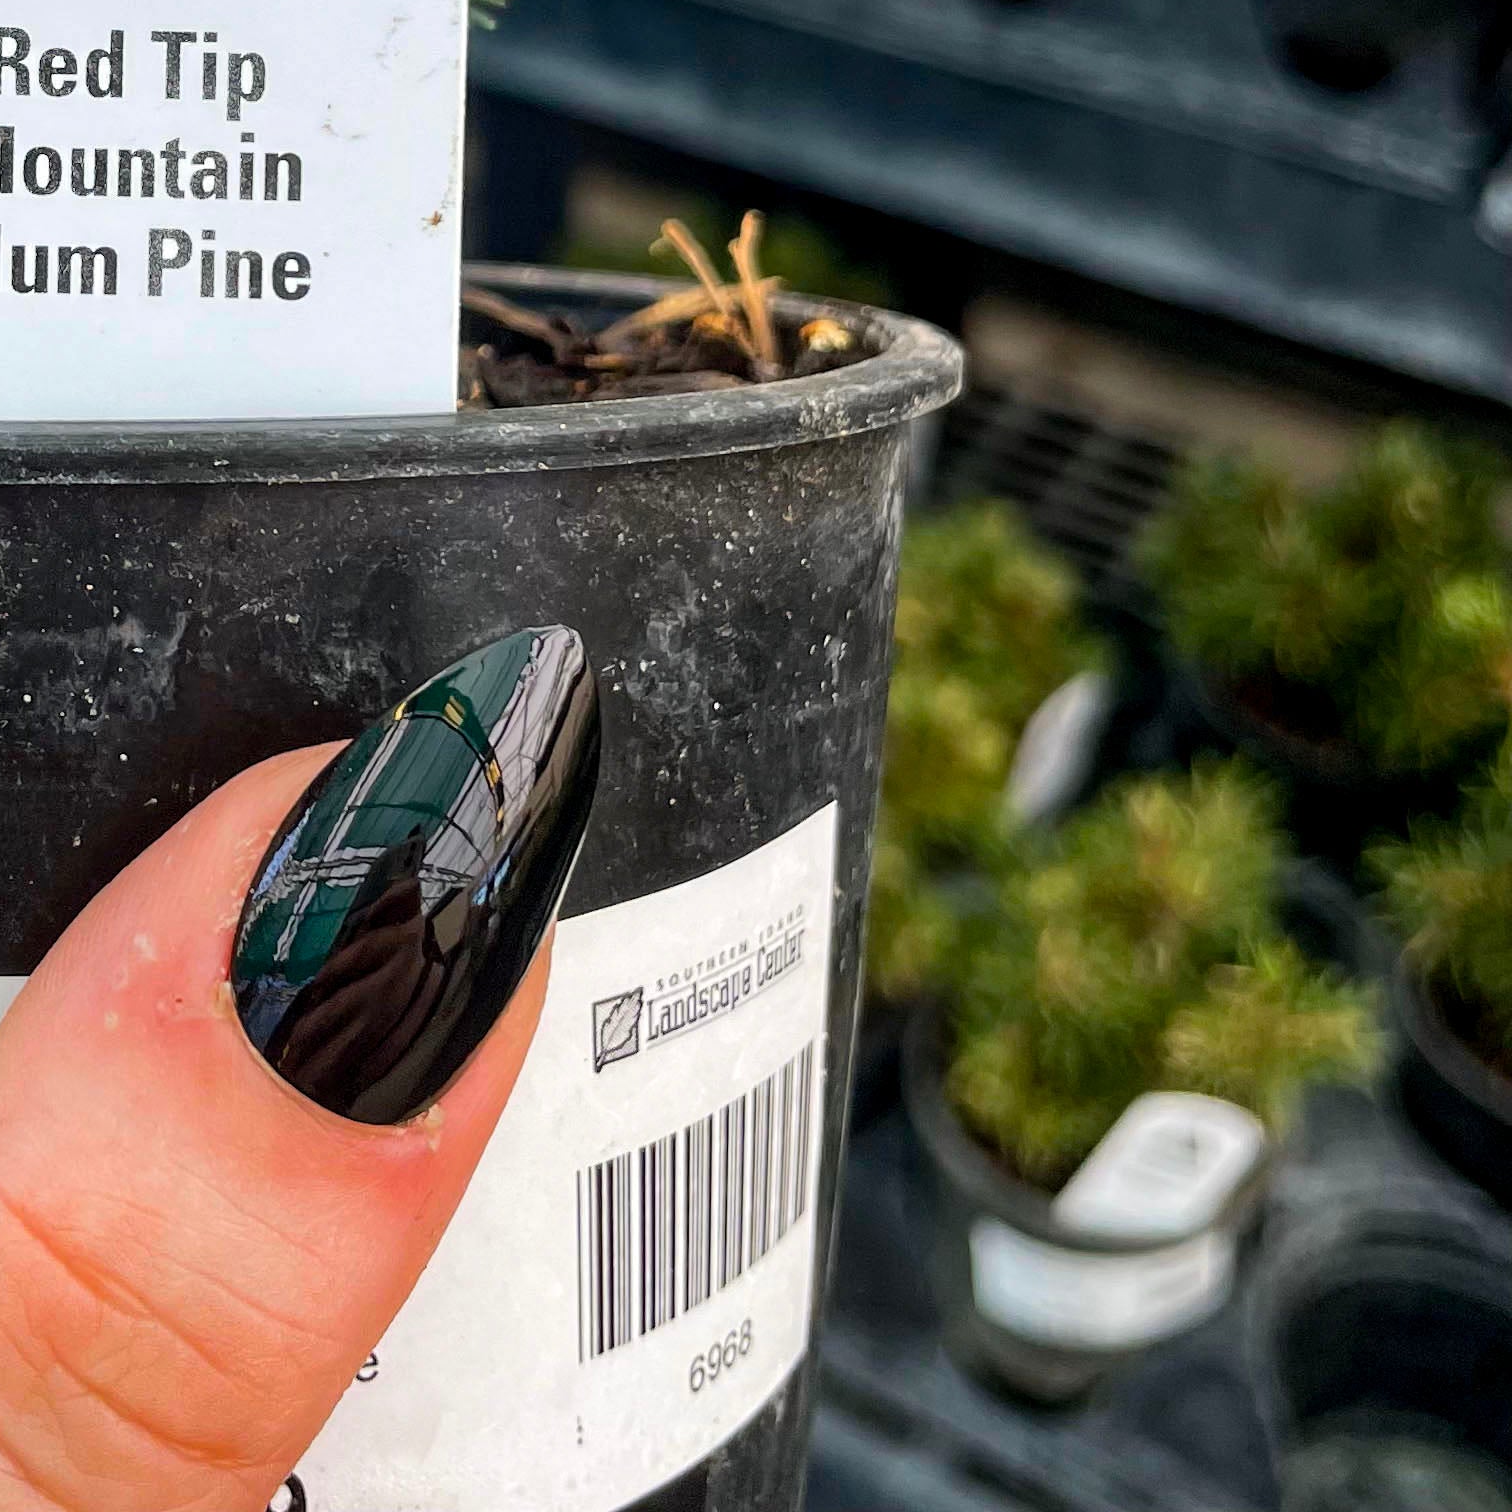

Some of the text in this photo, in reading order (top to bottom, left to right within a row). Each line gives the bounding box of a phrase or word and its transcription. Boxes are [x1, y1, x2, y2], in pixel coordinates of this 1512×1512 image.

[151, 30, 266, 121] Tip
[148, 228, 312, 301] Pine
[646, 927, 806, 1042] Landscape Center
[689, 1317, 752, 1393] 6968
